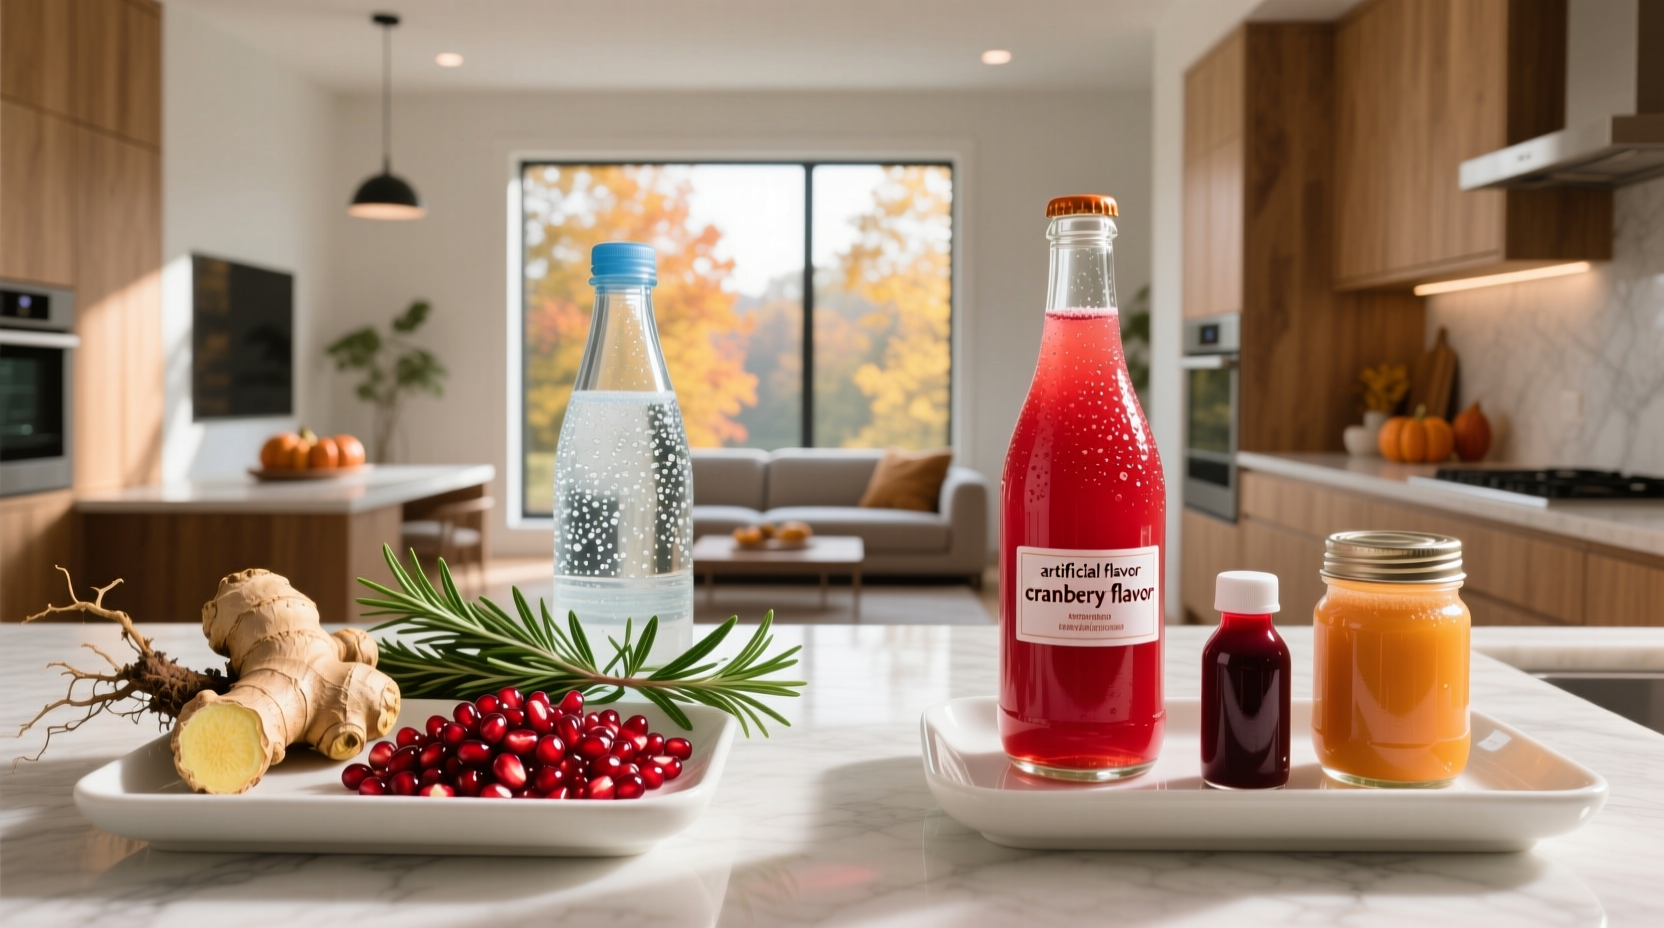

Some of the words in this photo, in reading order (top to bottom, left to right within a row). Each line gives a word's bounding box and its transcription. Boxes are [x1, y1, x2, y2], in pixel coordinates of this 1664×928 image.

[1040, 562, 1100, 578] artificial
[1104, 562, 1141, 578] flavor
[1025, 584, 1106, 608] cranbery
[1111, 583, 1155, 603] flavor
